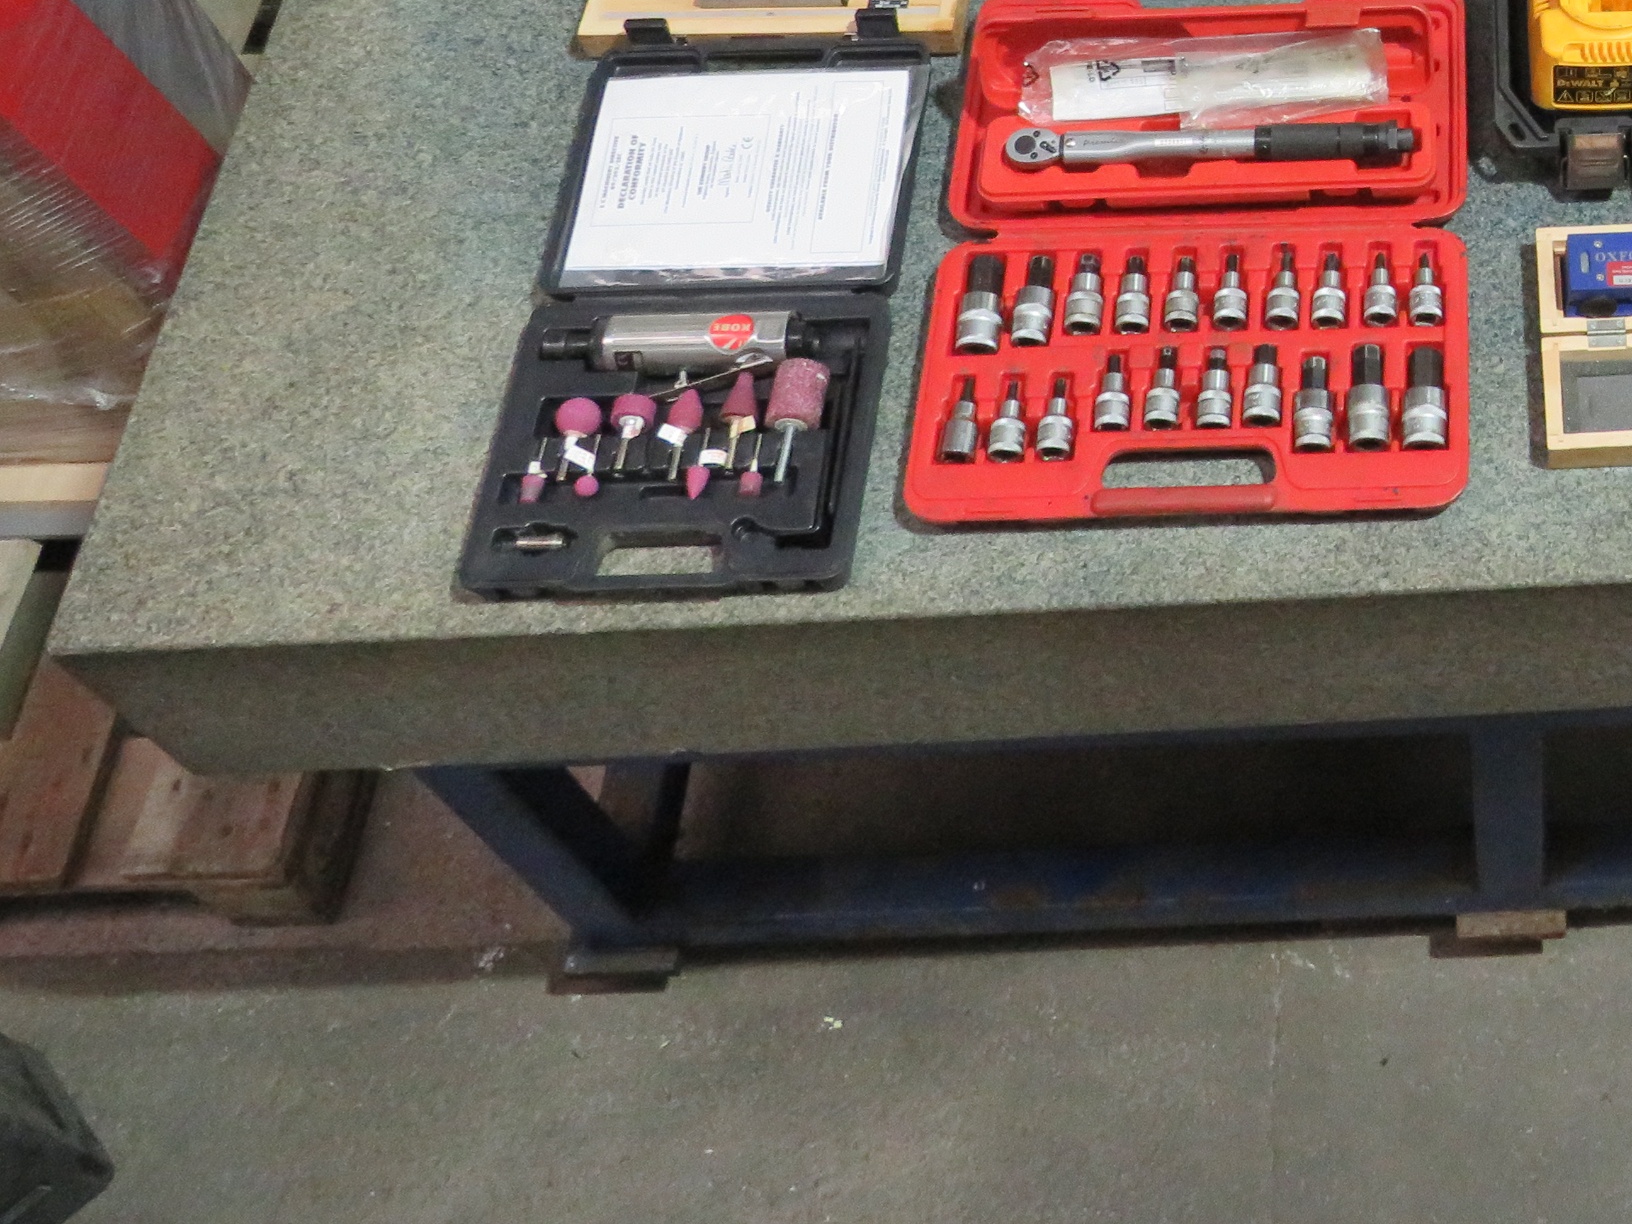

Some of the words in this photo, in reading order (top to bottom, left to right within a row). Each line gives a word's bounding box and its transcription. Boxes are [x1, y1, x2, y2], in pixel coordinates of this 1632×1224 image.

[617, 148, 637, 209] DECLARATION
[630, 135, 639, 147] OF
[628, 142, 647, 200] CONFORMITY
[712, 323, 752, 332] KOBE
